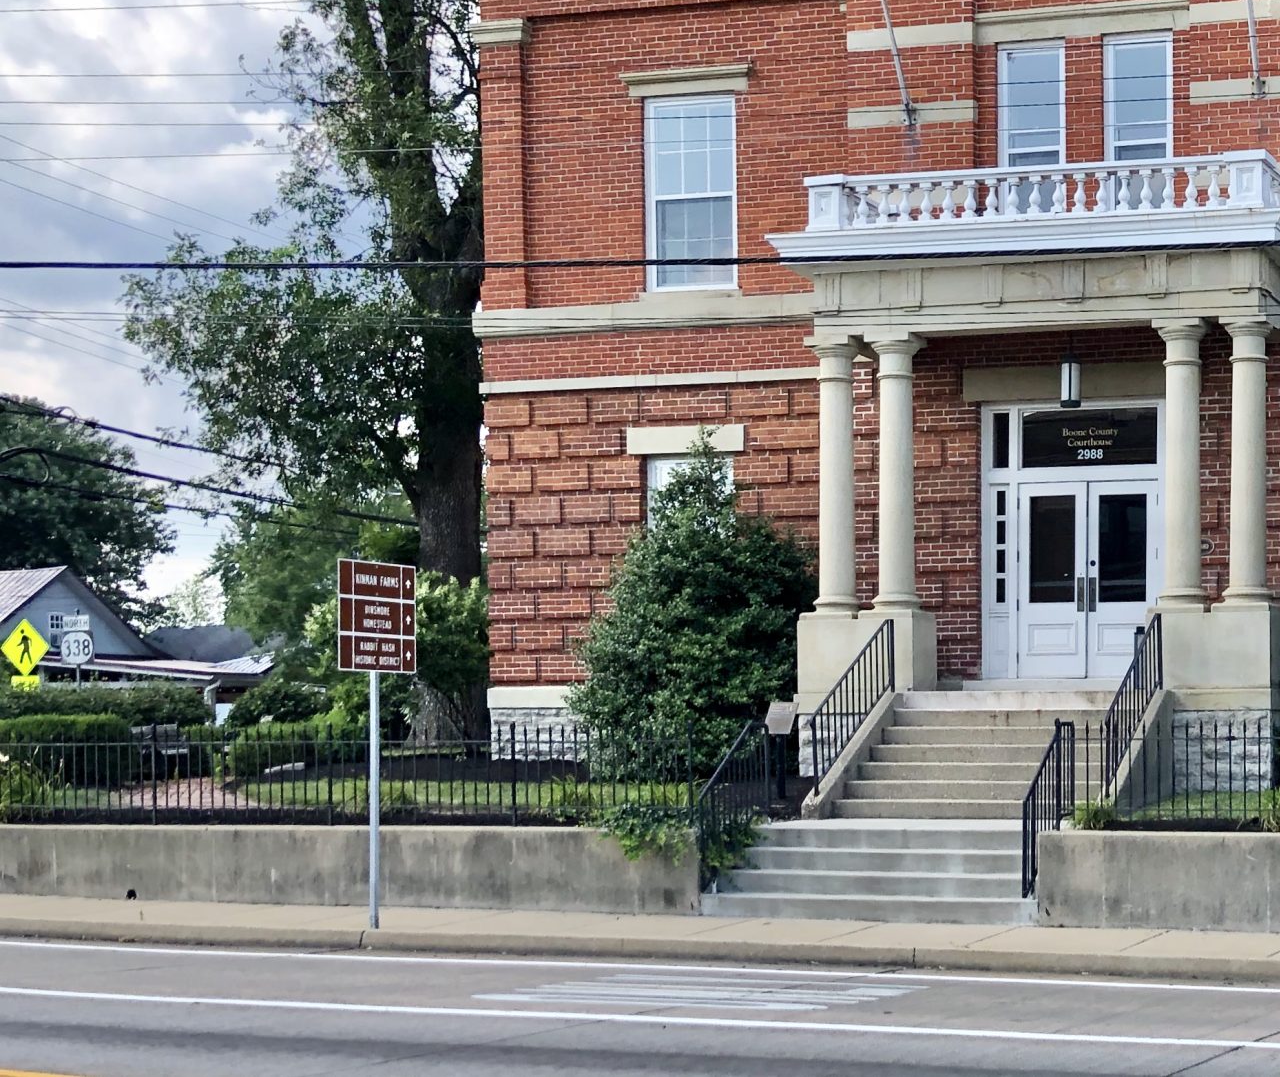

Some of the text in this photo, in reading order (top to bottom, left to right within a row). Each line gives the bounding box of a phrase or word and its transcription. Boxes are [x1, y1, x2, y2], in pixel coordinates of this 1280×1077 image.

[1062, 427, 1119, 437] Boone County
[1067, 438, 1113, 447] Courthouse
[1077, 449, 1104, 460] 2988
[380, 576, 399, 588] FARMS
[364, 605, 390, 616] DINSMORE
[64, 618, 89, 628] NORTH
[363, 619, 392, 629] HOMESTEAD
[63, 638, 91, 657] 338
[360, 641, 395, 652] RABBIT HASH
[355, 655, 377, 664] HISTORIC
